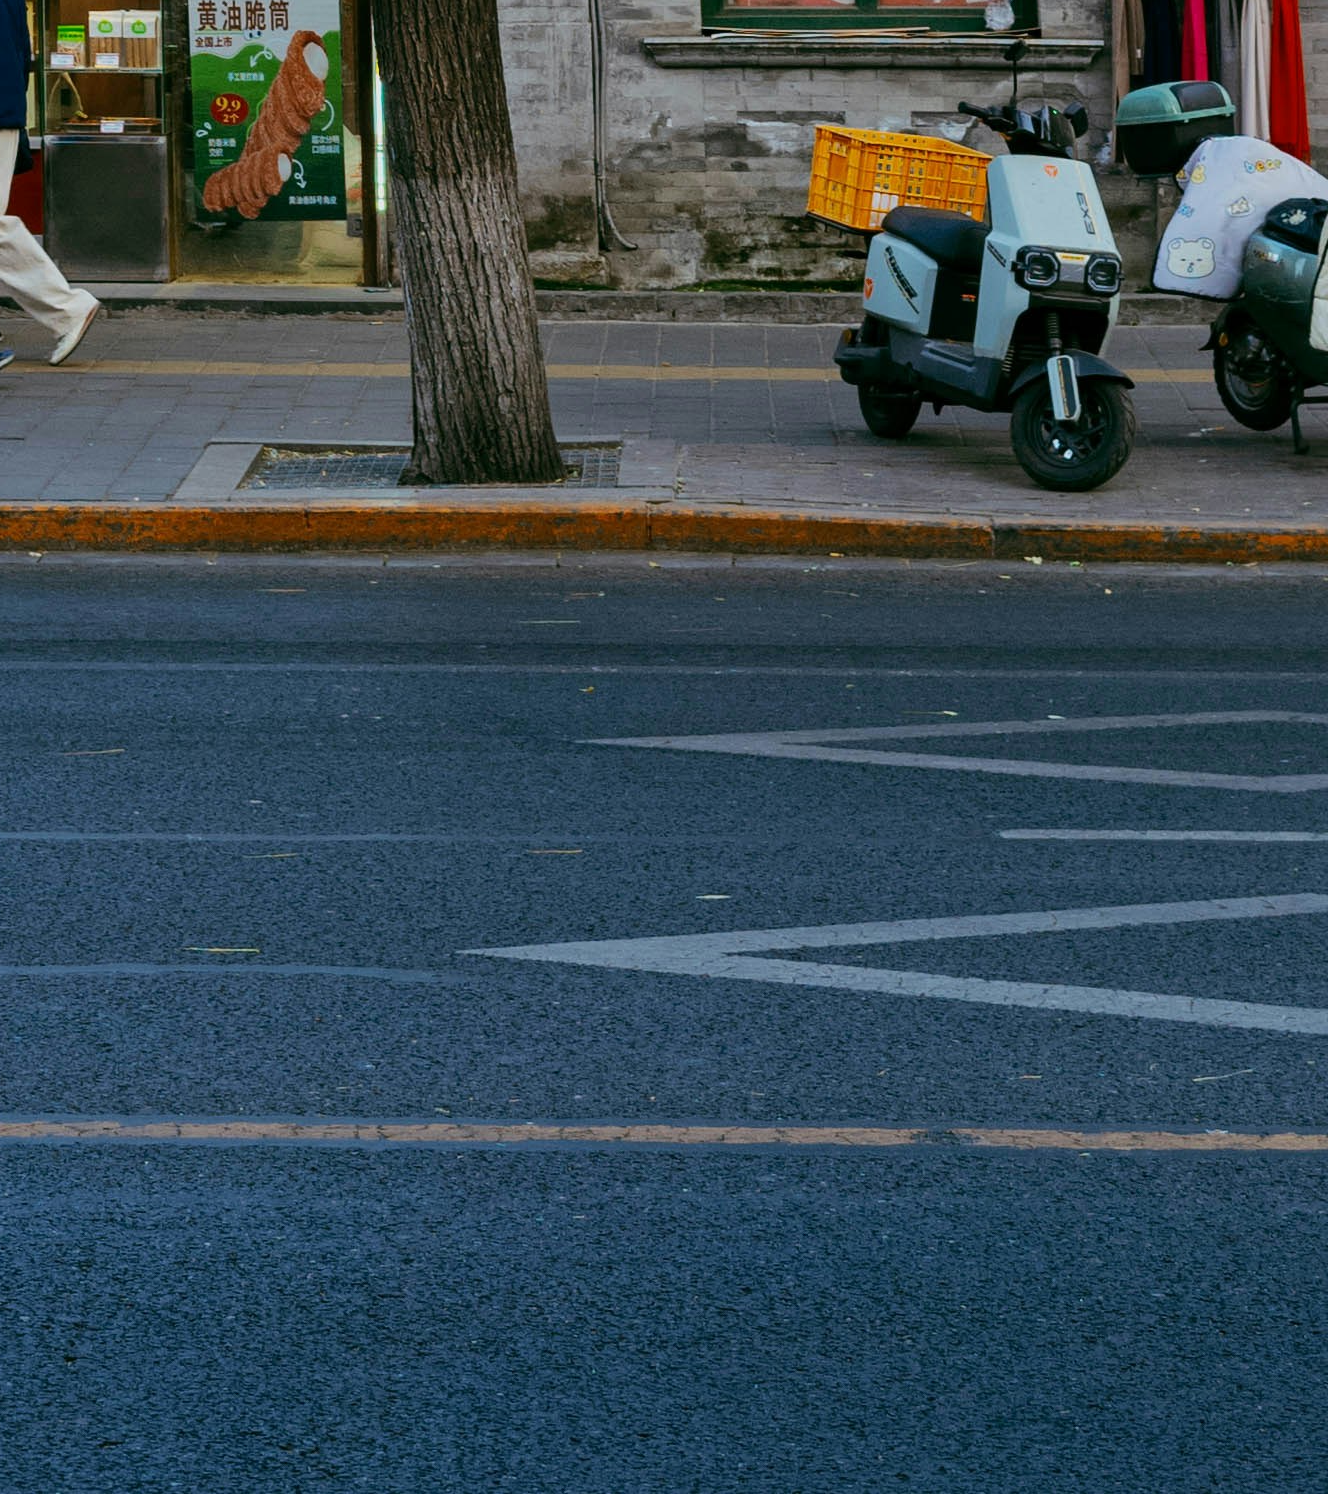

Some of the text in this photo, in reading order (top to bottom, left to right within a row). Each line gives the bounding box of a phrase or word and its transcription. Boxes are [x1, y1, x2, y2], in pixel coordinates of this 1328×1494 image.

[197, 0, 290, 31] 黄油脆筒
[195, 36, 233, 48] 全国上市
[215, 96, 241, 113] 9.9
[223, 114, 240, 123] 2个
